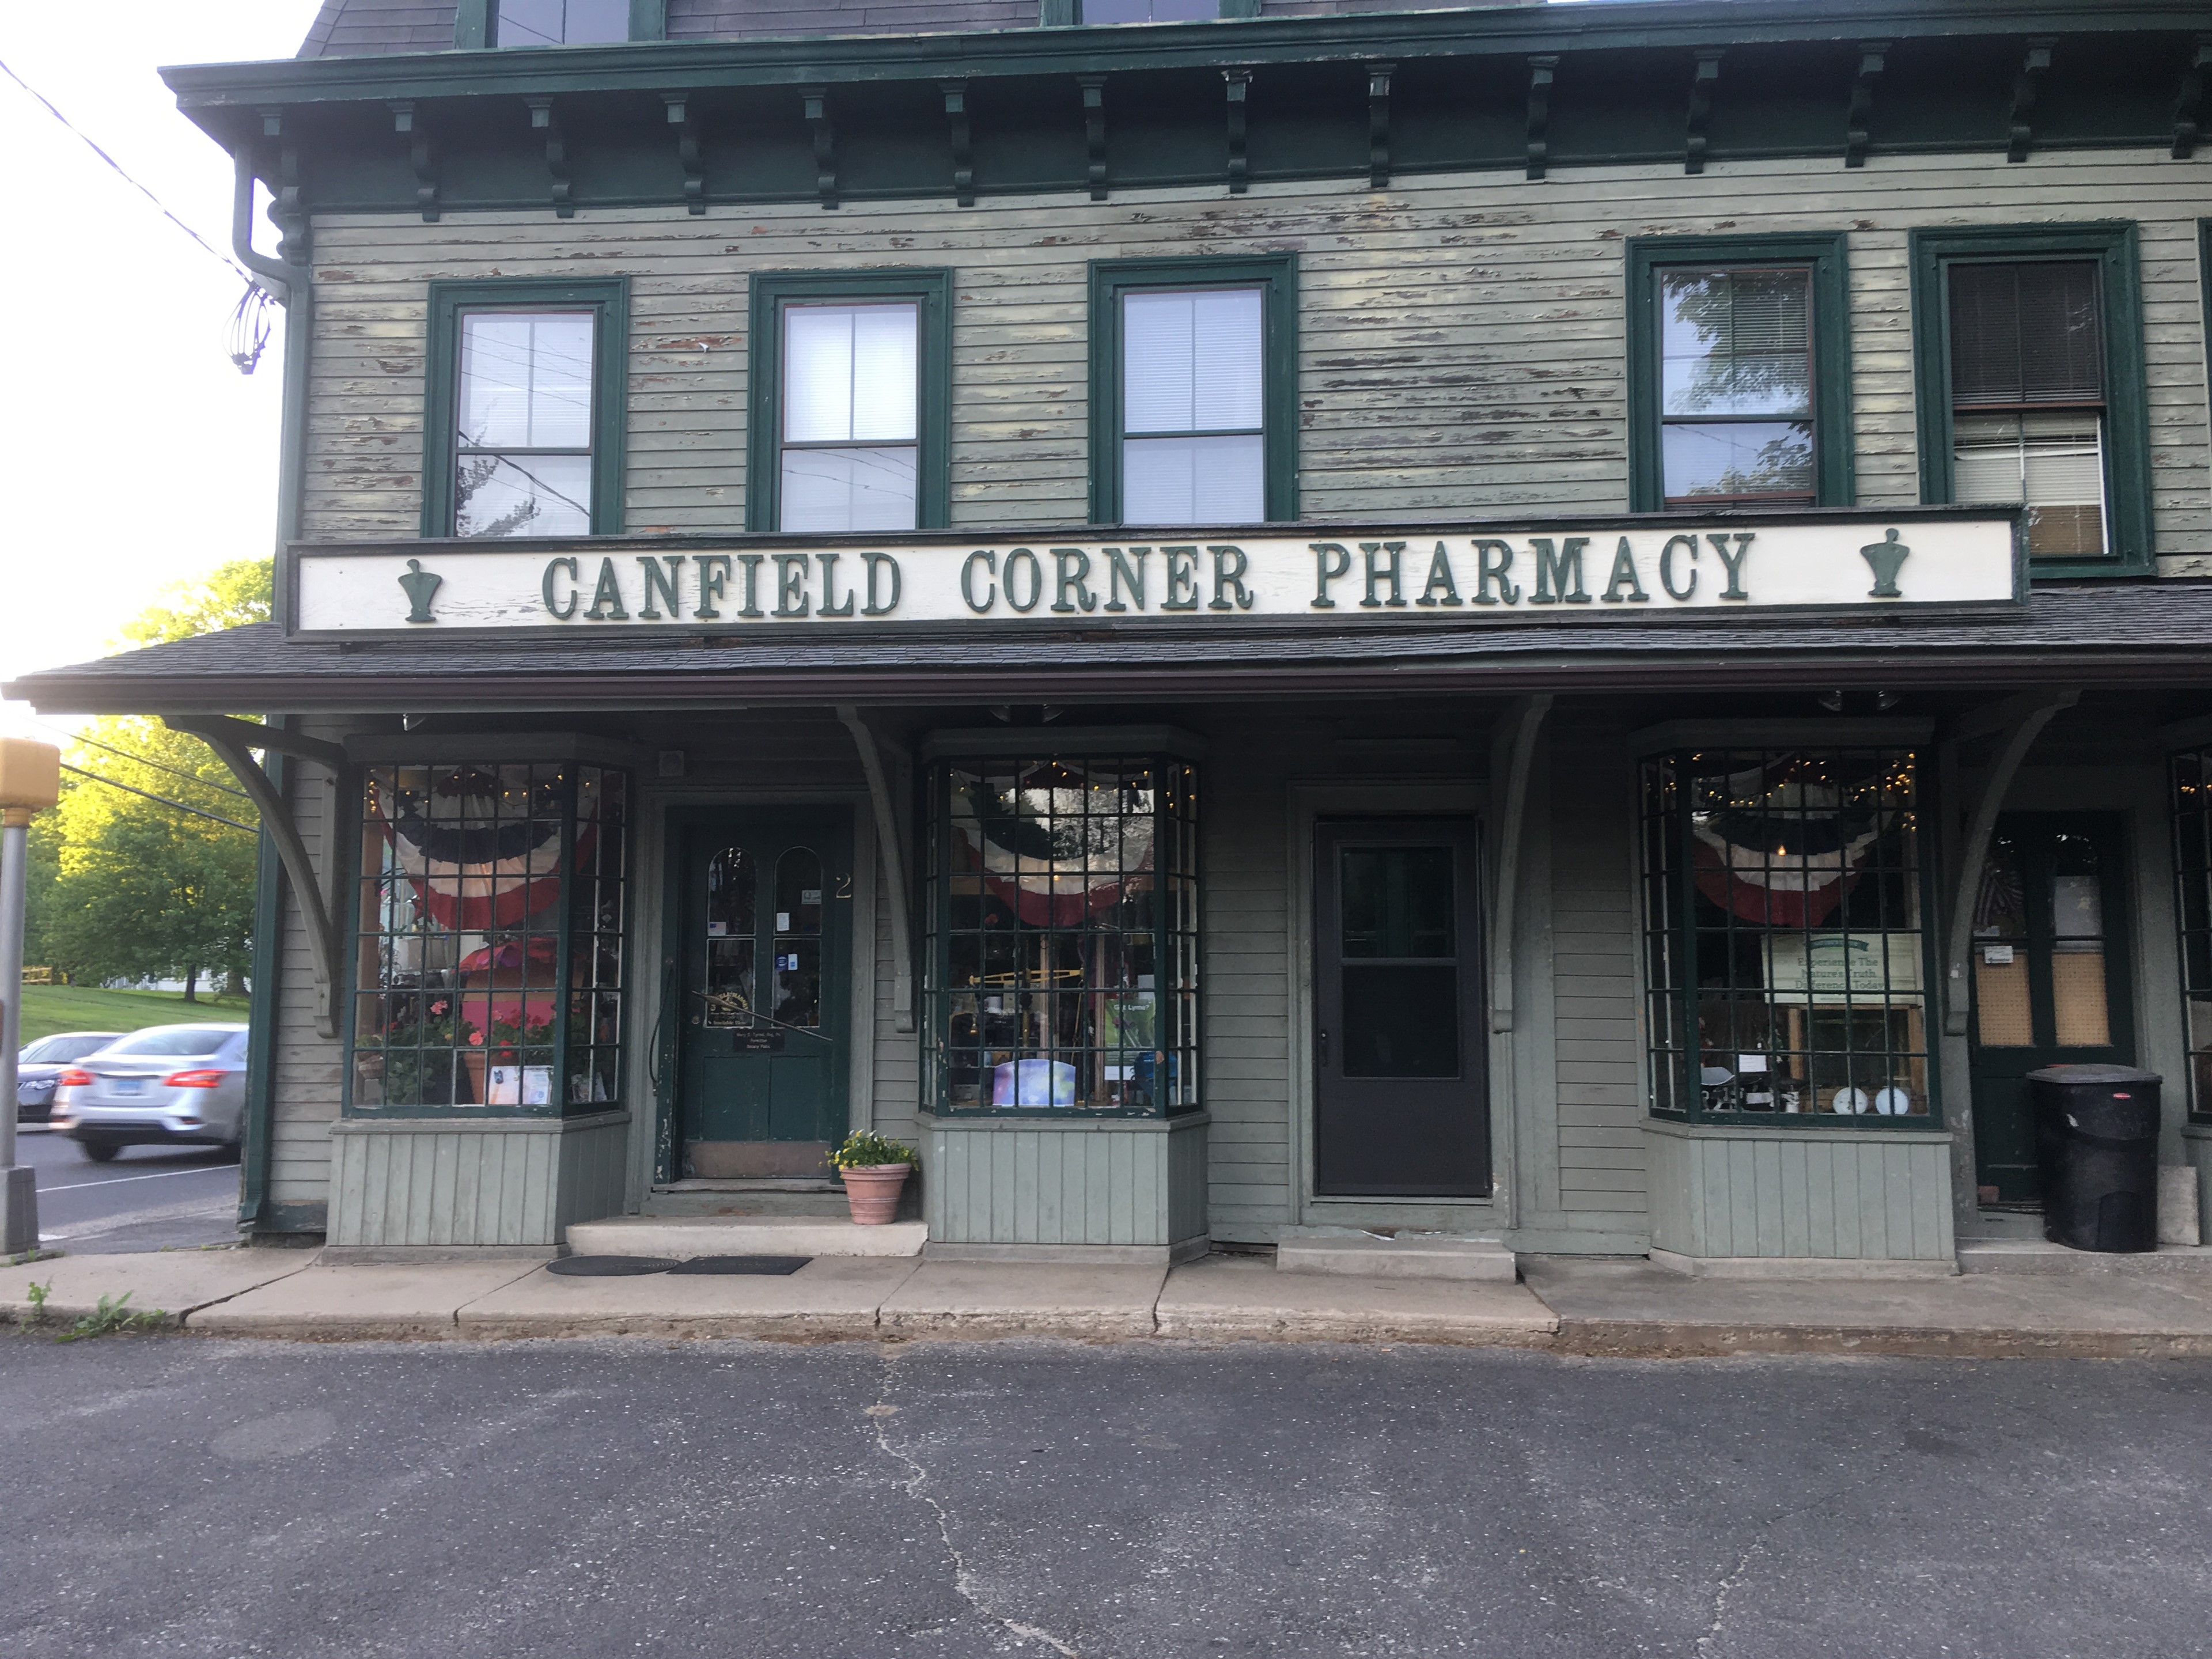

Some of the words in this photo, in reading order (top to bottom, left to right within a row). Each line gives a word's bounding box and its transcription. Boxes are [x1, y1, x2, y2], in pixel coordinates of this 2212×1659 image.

[542, 552, 902, 619] CANFIELD
[961, 546, 1253, 613] CORNER
[1308, 533, 1755, 607] PHARMACY
[836, 872, 852, 899] 2
[1798, 957, 1856, 968] Eperiene
[1858, 957, 1878, 966] The
